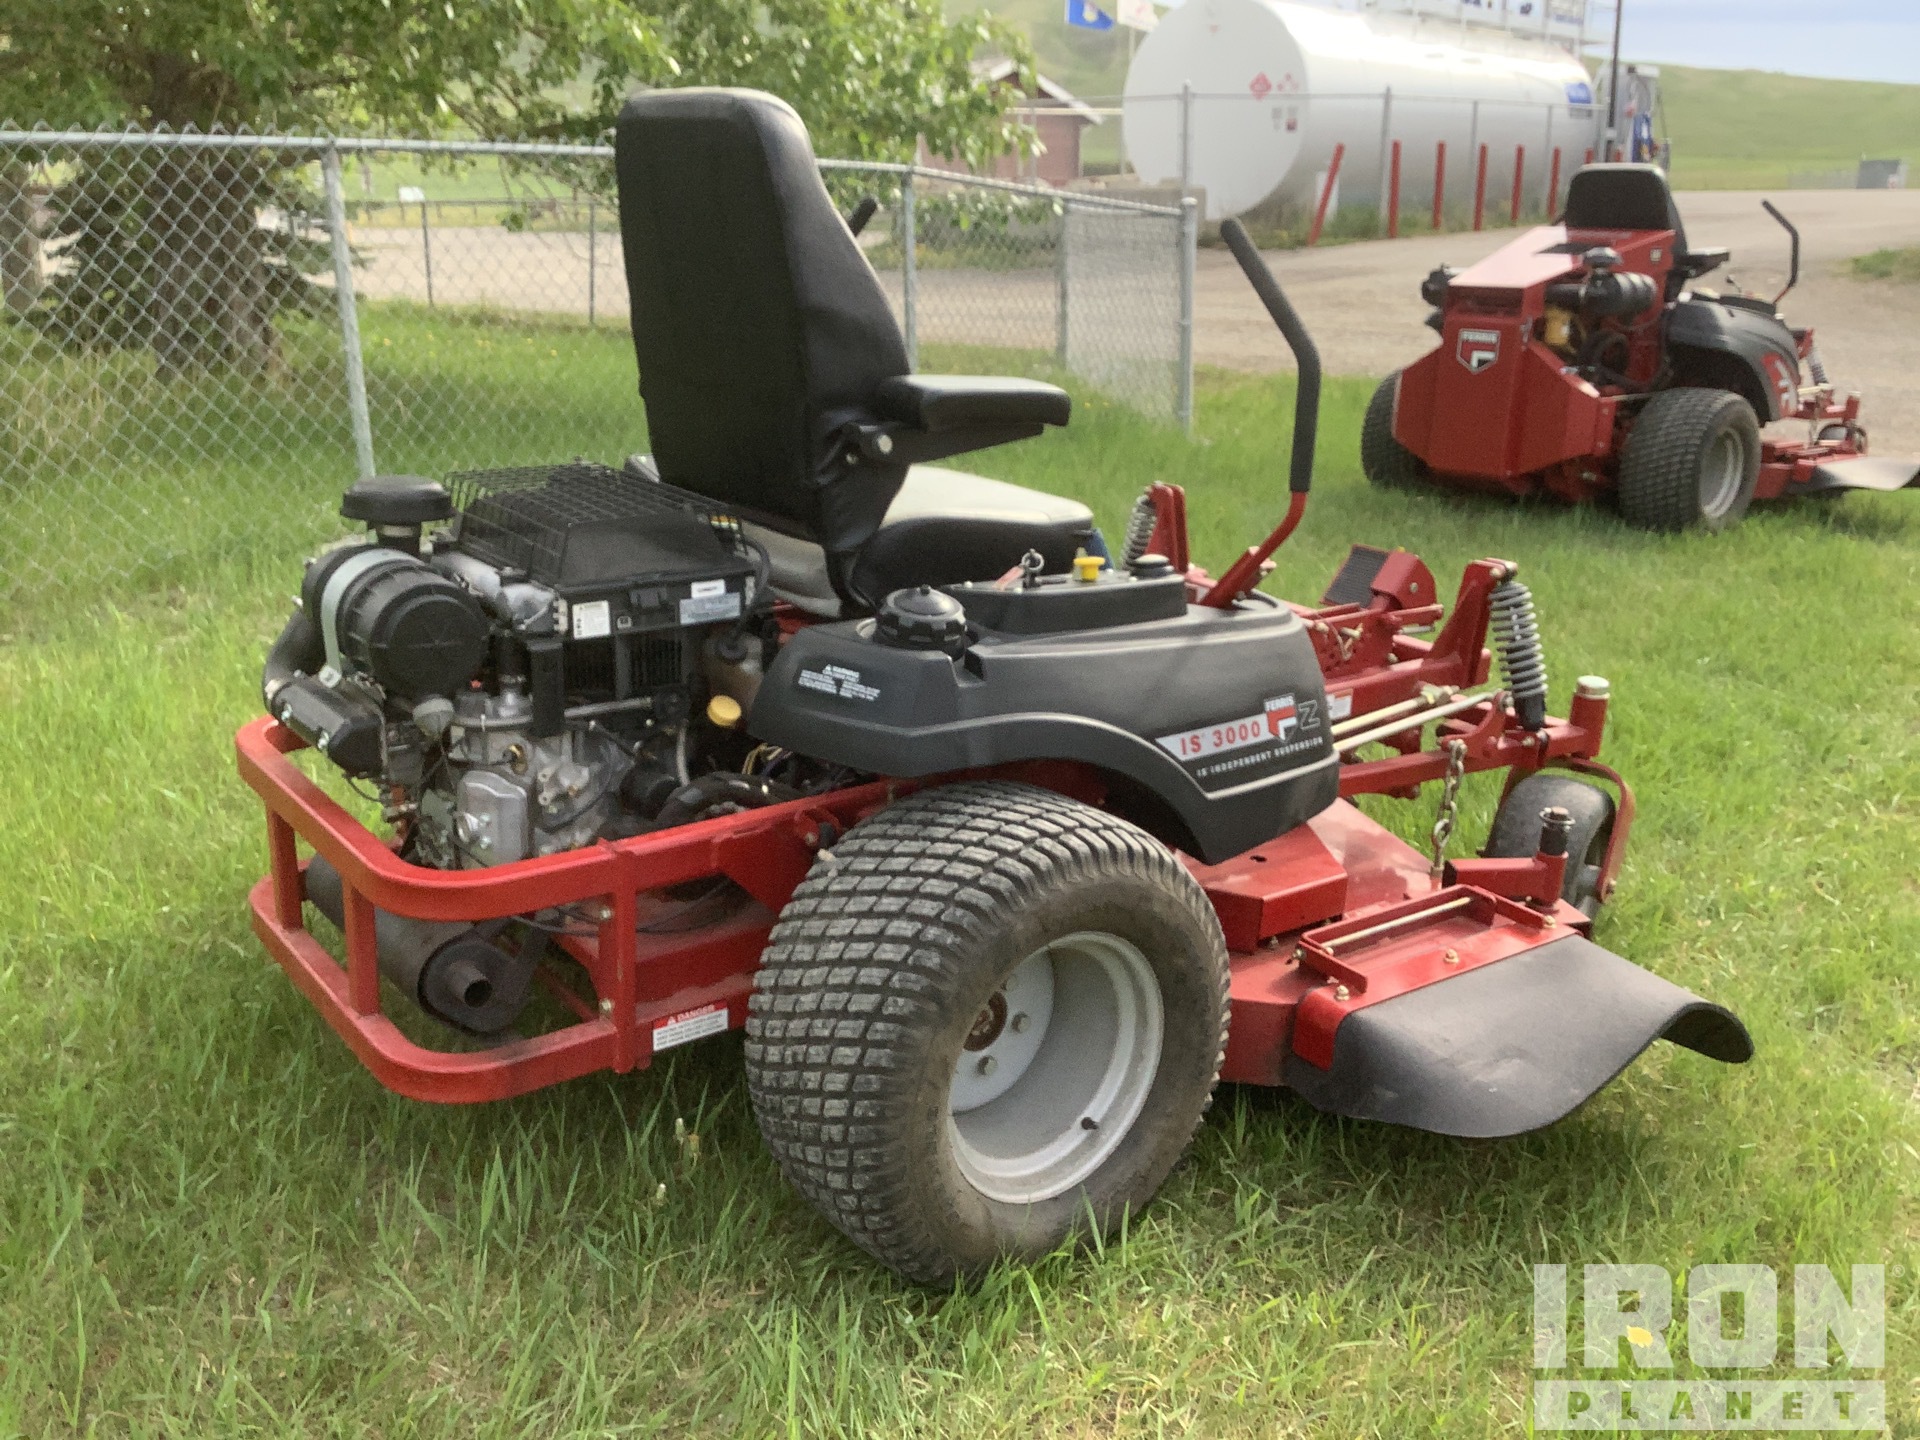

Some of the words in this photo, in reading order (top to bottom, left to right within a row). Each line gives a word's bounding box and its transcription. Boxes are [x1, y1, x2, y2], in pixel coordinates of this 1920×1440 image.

[1298, 700, 1321, 730] Z
[1180, 735, 1202, 756] IS
[1213, 721, 1260, 747] 3000
[1210, 750, 1271, 773] INDEPENDENT
[1274, 736, 1324, 758] SUSPENSION
